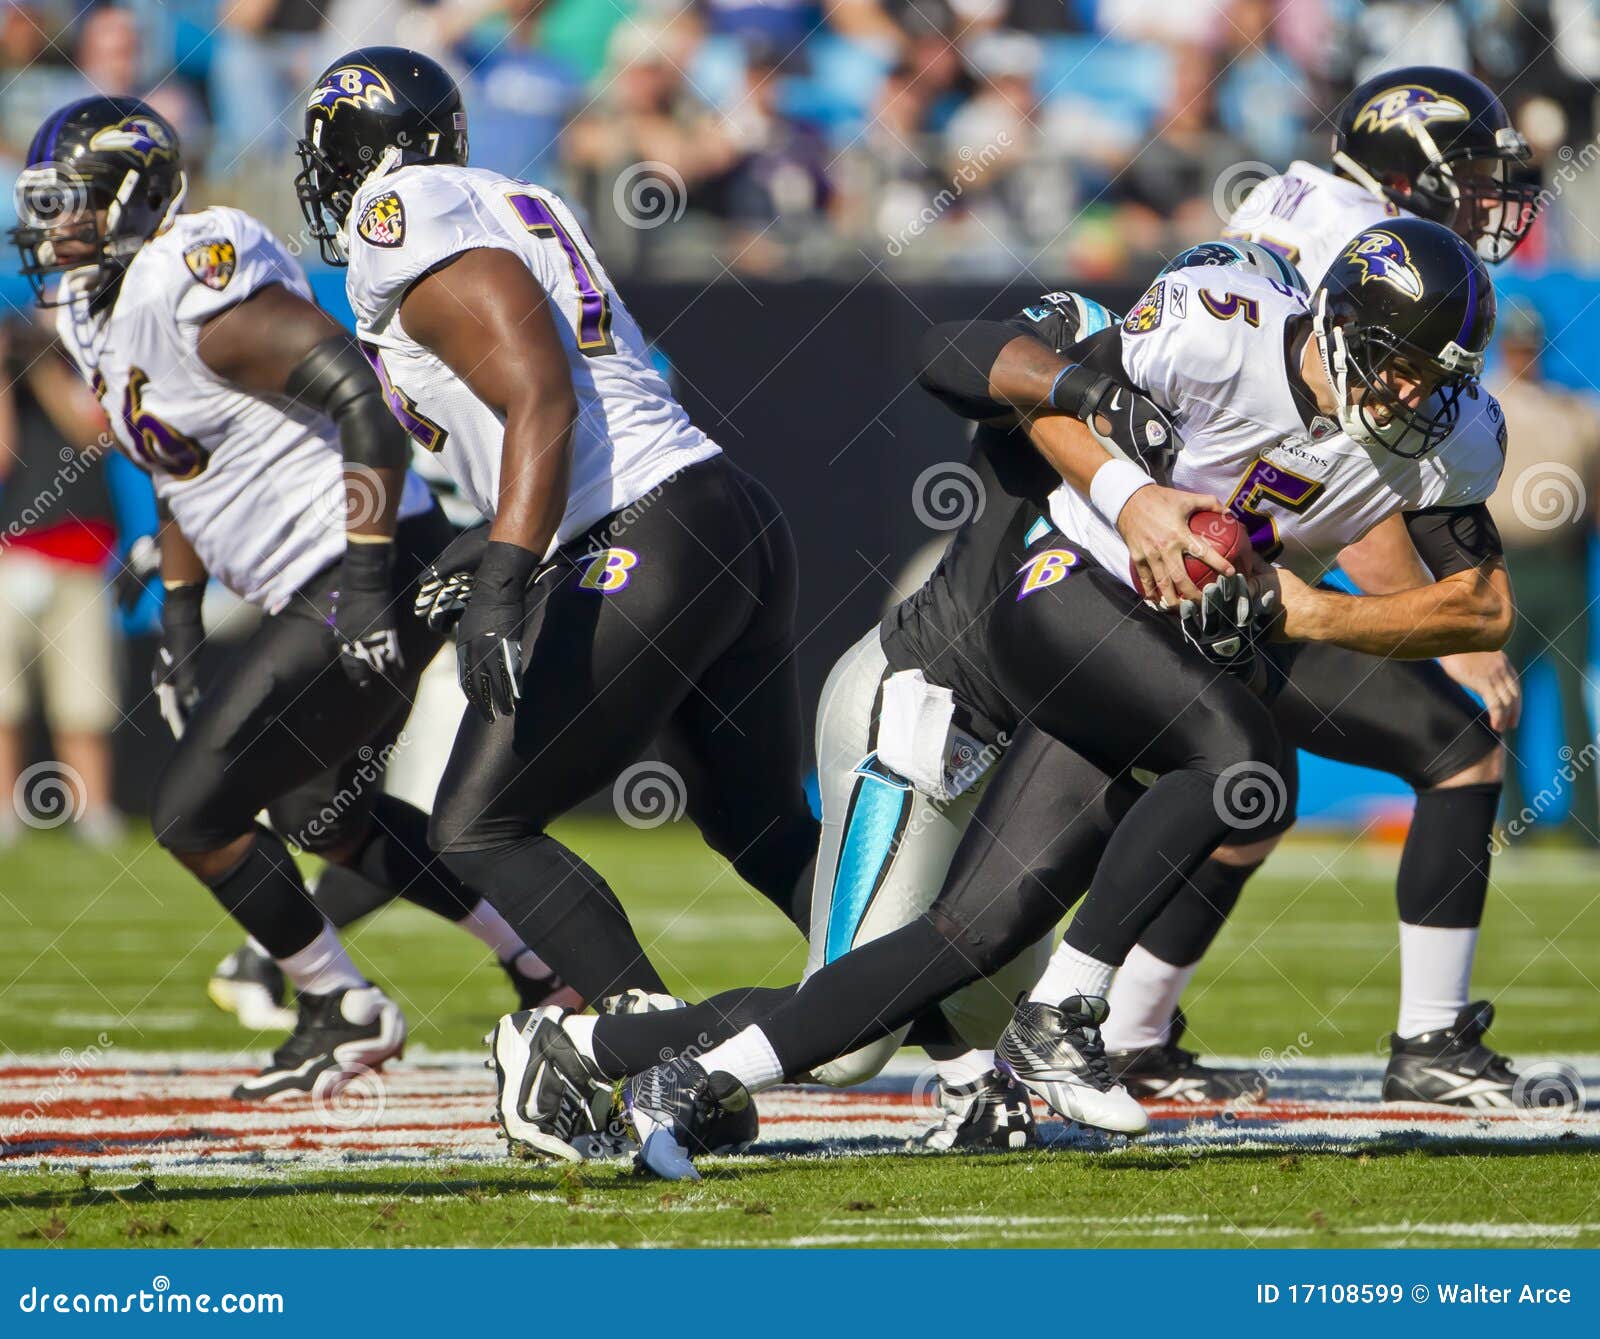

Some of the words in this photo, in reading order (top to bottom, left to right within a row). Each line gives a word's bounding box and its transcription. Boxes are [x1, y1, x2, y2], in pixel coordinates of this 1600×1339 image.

[1199, 287, 1260, 329] 5
[92, 366, 212, 482] 6
[1226, 456, 1326, 563] 5
[576, 547, 641, 595] B
[1015, 548, 1081, 602] B
